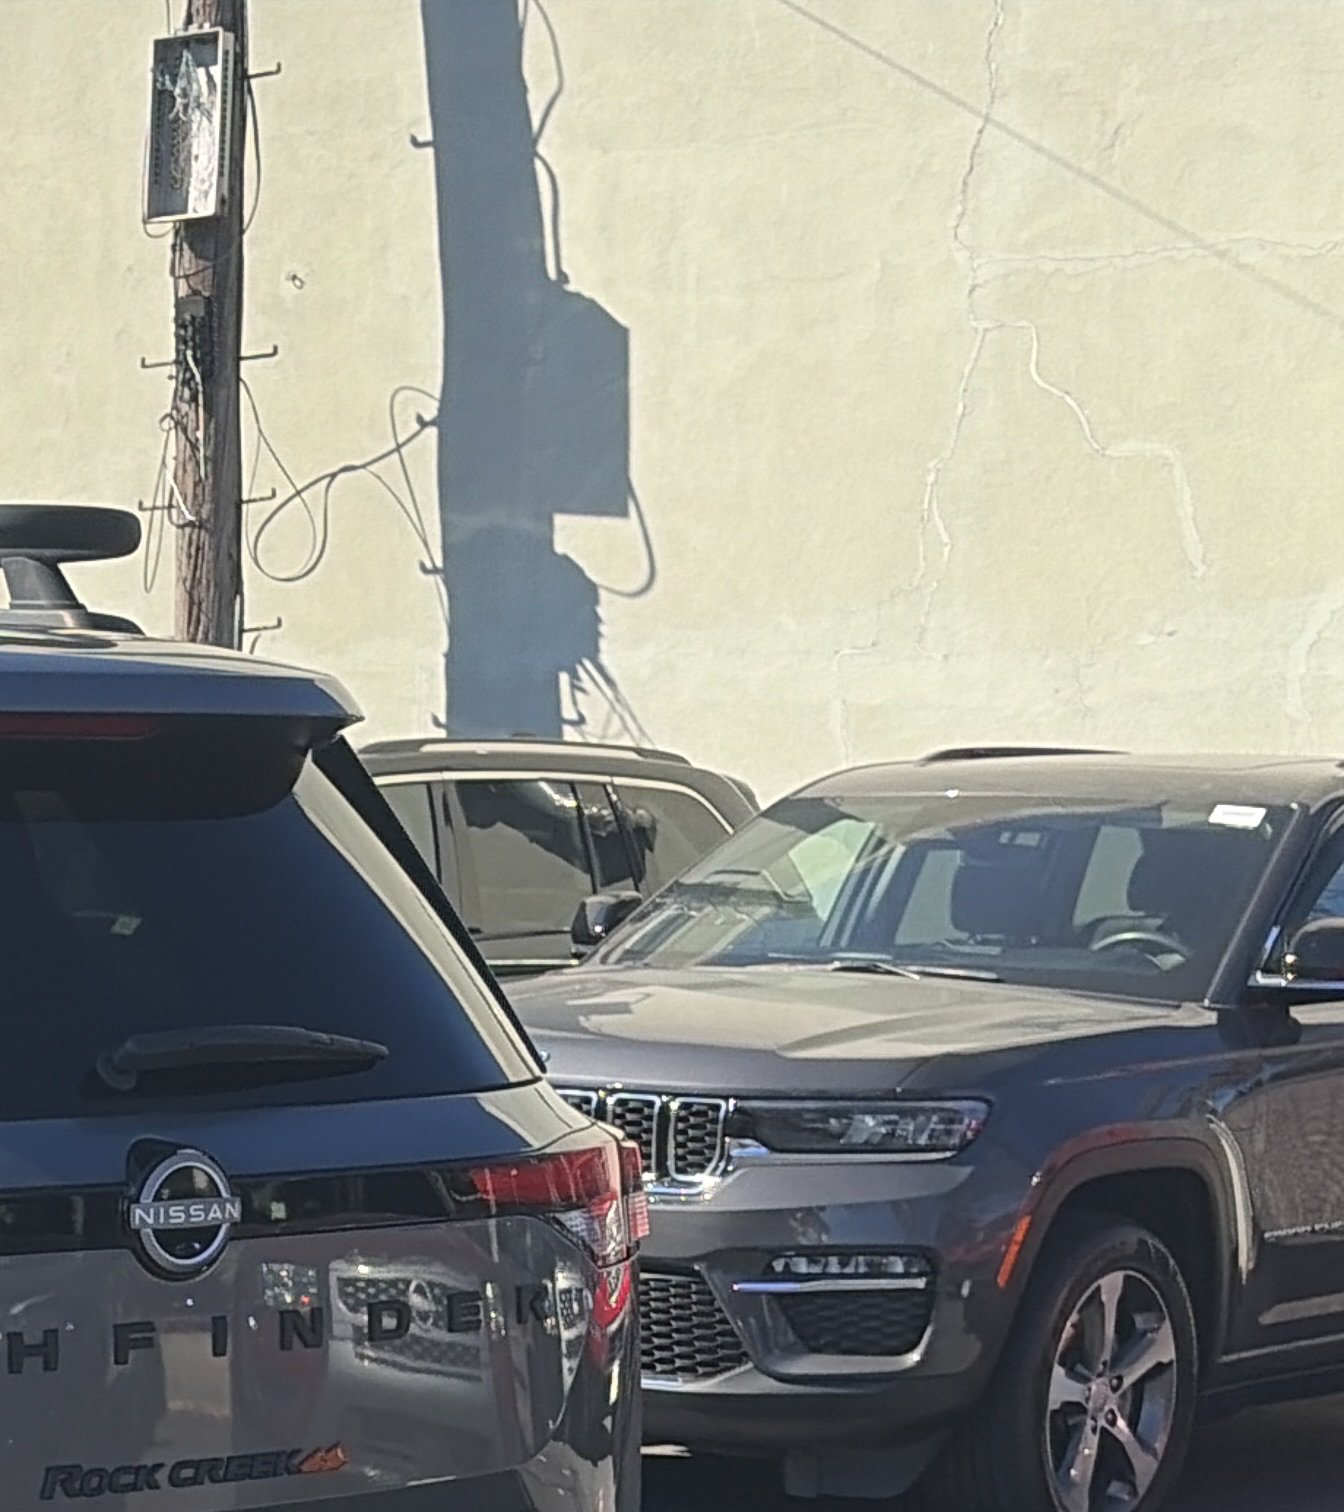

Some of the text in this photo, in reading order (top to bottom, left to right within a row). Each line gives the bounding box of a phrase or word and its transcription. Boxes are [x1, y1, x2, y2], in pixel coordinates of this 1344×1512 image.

[134, 1202, 240, 1226] NISSAN
[39, 1449, 306, 1500] ROCK CREEK
